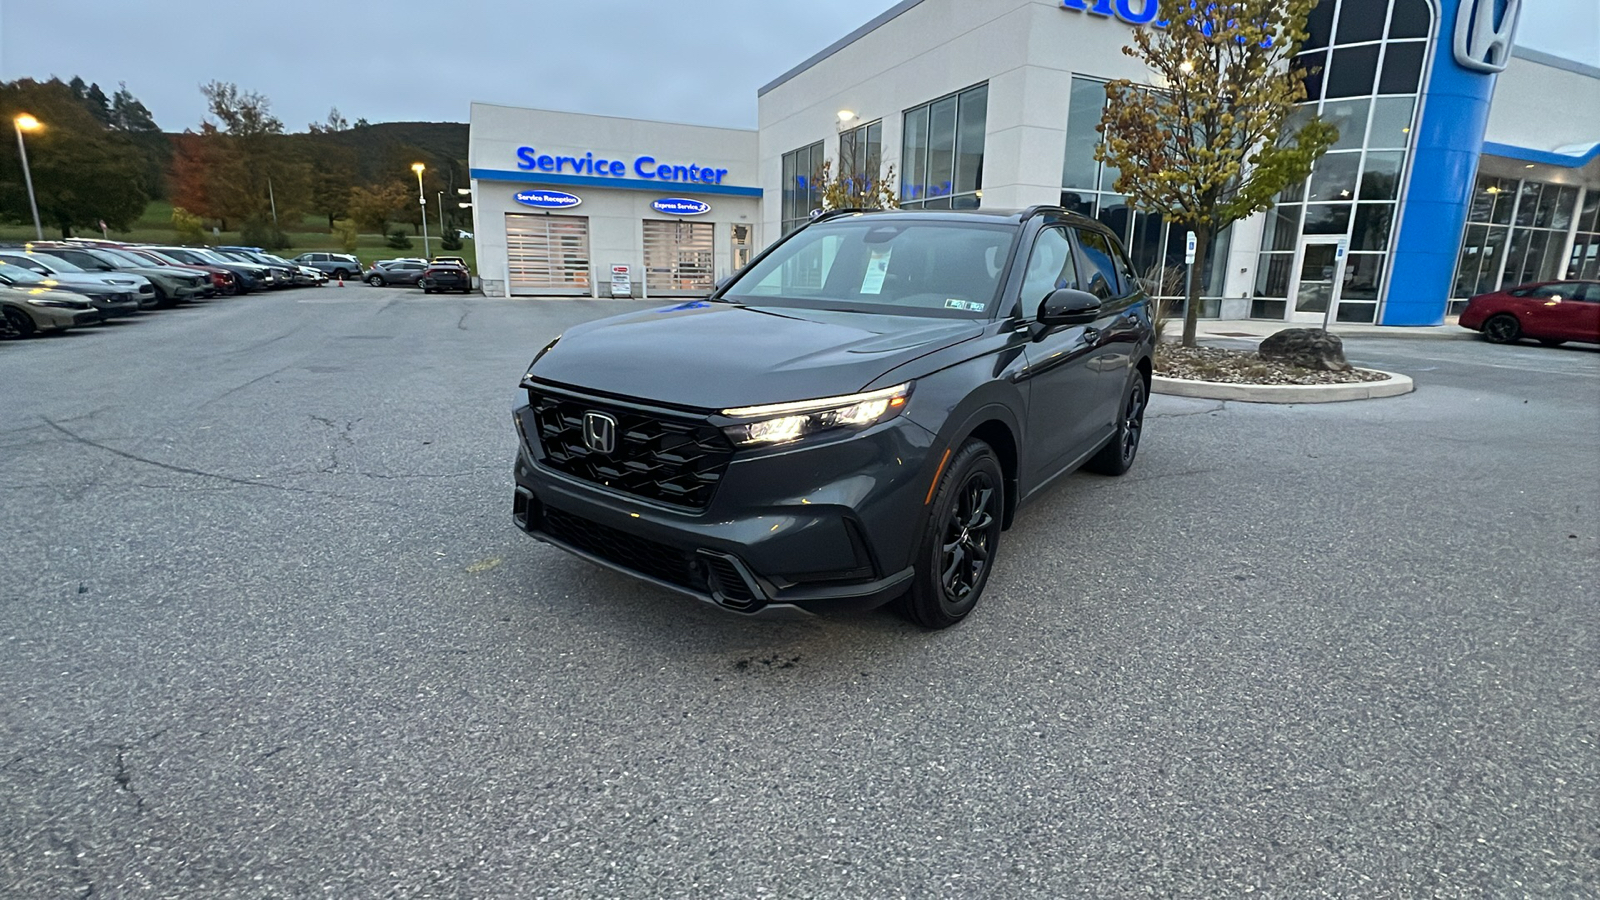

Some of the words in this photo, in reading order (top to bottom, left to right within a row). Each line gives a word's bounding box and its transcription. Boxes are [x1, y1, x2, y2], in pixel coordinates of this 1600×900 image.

[517, 146, 625, 177] Service
[634, 156, 728, 184] Center
[517, 193, 543, 202] Service
[543, 194, 577, 204] Reception
[654, 201, 676, 210] Express
[677, 202, 699, 210] Service
